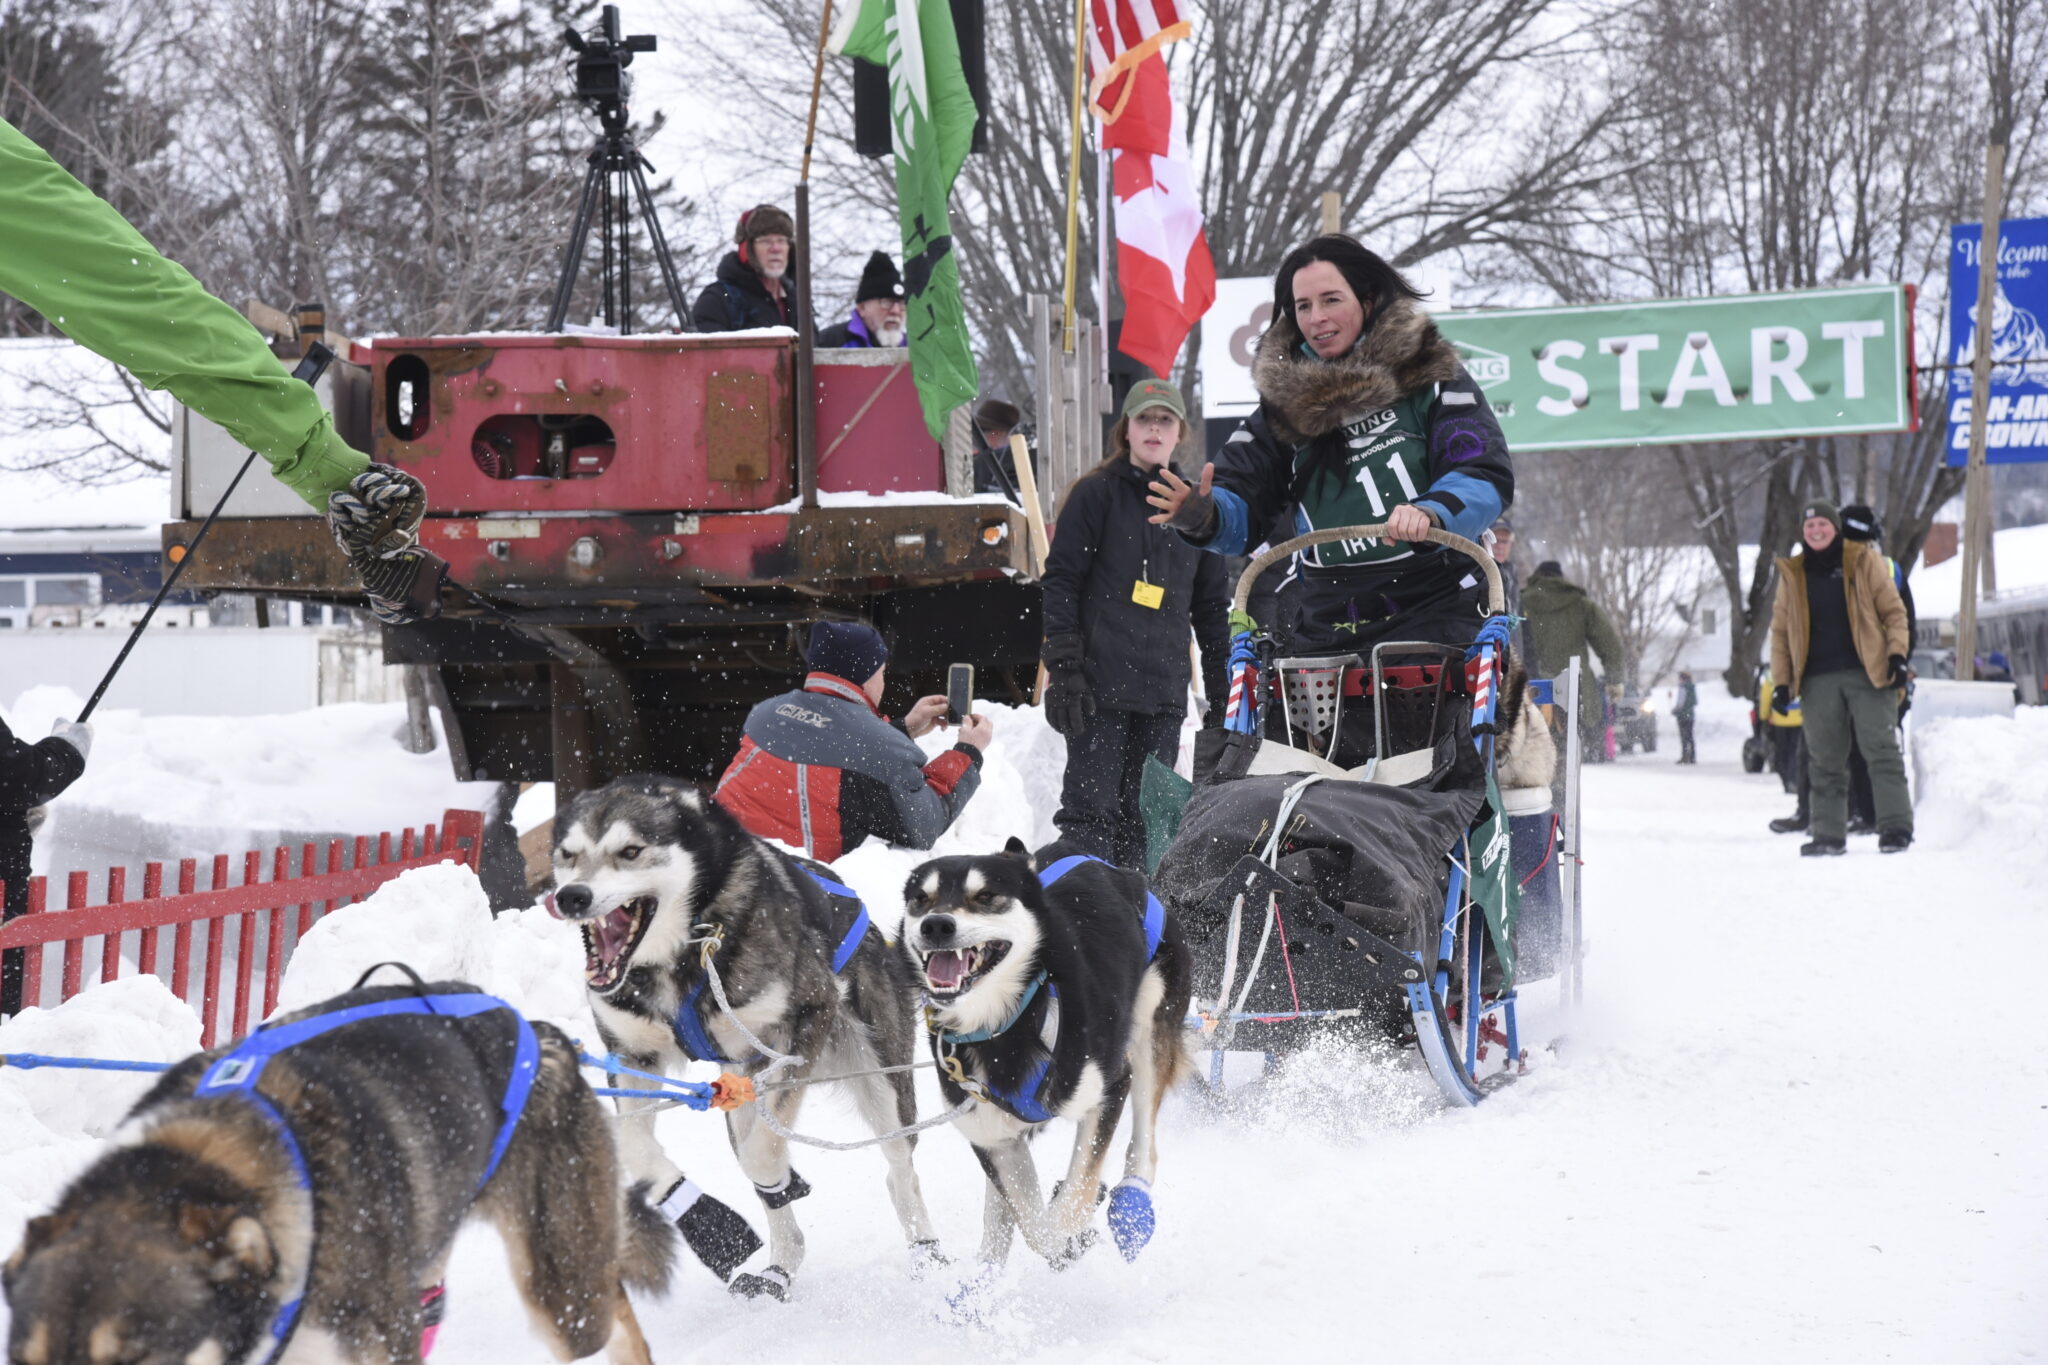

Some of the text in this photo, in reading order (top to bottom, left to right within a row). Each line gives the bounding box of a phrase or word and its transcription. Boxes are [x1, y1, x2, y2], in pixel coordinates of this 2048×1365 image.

[1536, 320, 1884, 416] START
[1345, 409, 1397, 436] VING
[1952, 421, 2048, 450] COWN
[1355, 451, 1419, 518] 11
